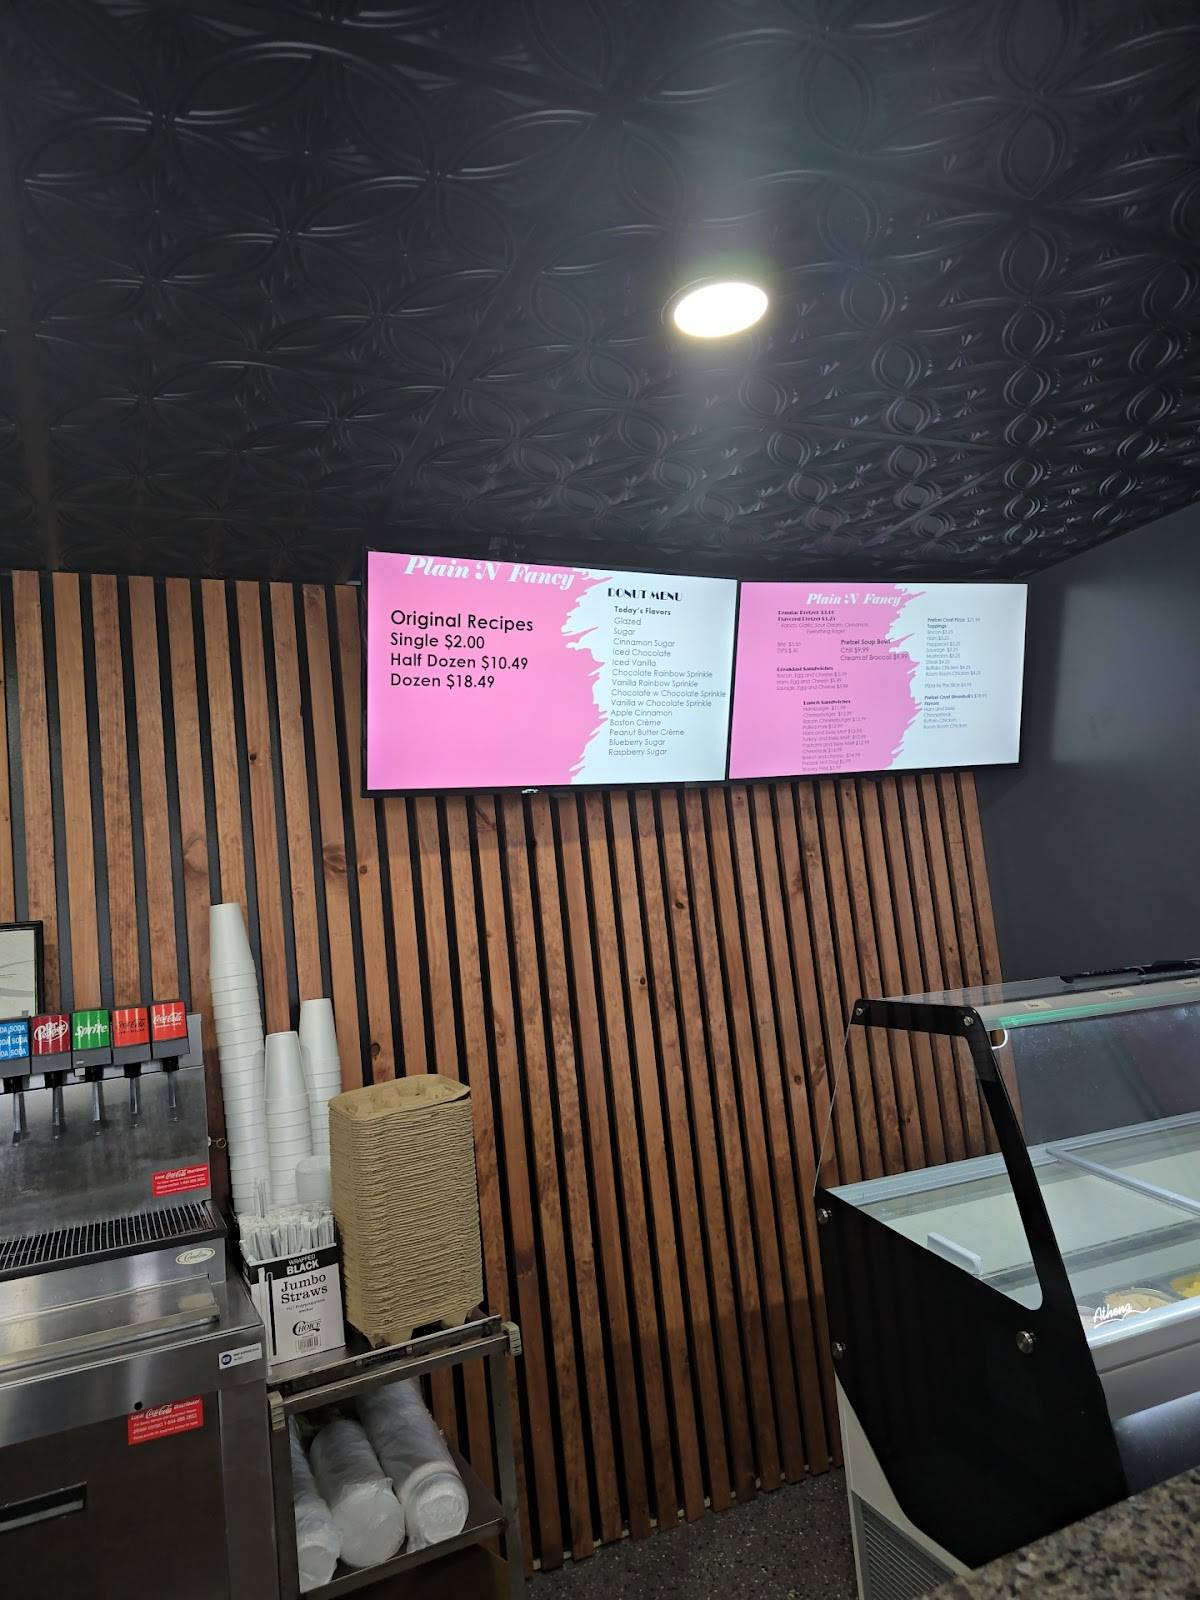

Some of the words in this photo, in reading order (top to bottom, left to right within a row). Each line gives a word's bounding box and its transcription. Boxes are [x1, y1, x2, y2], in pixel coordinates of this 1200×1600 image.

[404, 555, 469, 579] Plain
[508, 564, 575, 590] Fancy
[608, 588, 646, 599] DONUT
[650, 592, 682, 601] MENU
[806, 593, 841, 605] Plain
[864, 593, 901, 607] Fancy
[614, 606, 643, 615] Today's
[391, 610, 460, 629] Original
[468, 614, 533, 633] Recipes
[614, 617, 641, 625] Glazed
[614, 628, 635, 636] Sugar
[391, 633, 439, 649] Single
[445, 634, 484, 650] $2.00
[654, 640, 675, 648] Sugar
[632, 649, 671, 657] Chocolate
[391, 653, 422, 666] Half
[428, 654, 475, 668] Dozen
[481, 656, 528, 671] $10.49
[612, 669, 652, 677] Chocolate
[391, 674, 440, 687] Dozen
[447, 674, 494, 689] $18.49
[609, 739, 642, 747] Blueberry
[609, 749, 644, 757] Raspberry
[75, 1022, 107, 1037] Sprite
[287, 1259, 319, 1275] BLACK
[281, 1274, 326, 1293] Jumbo
[281, 1286, 328, 1304] Straws
